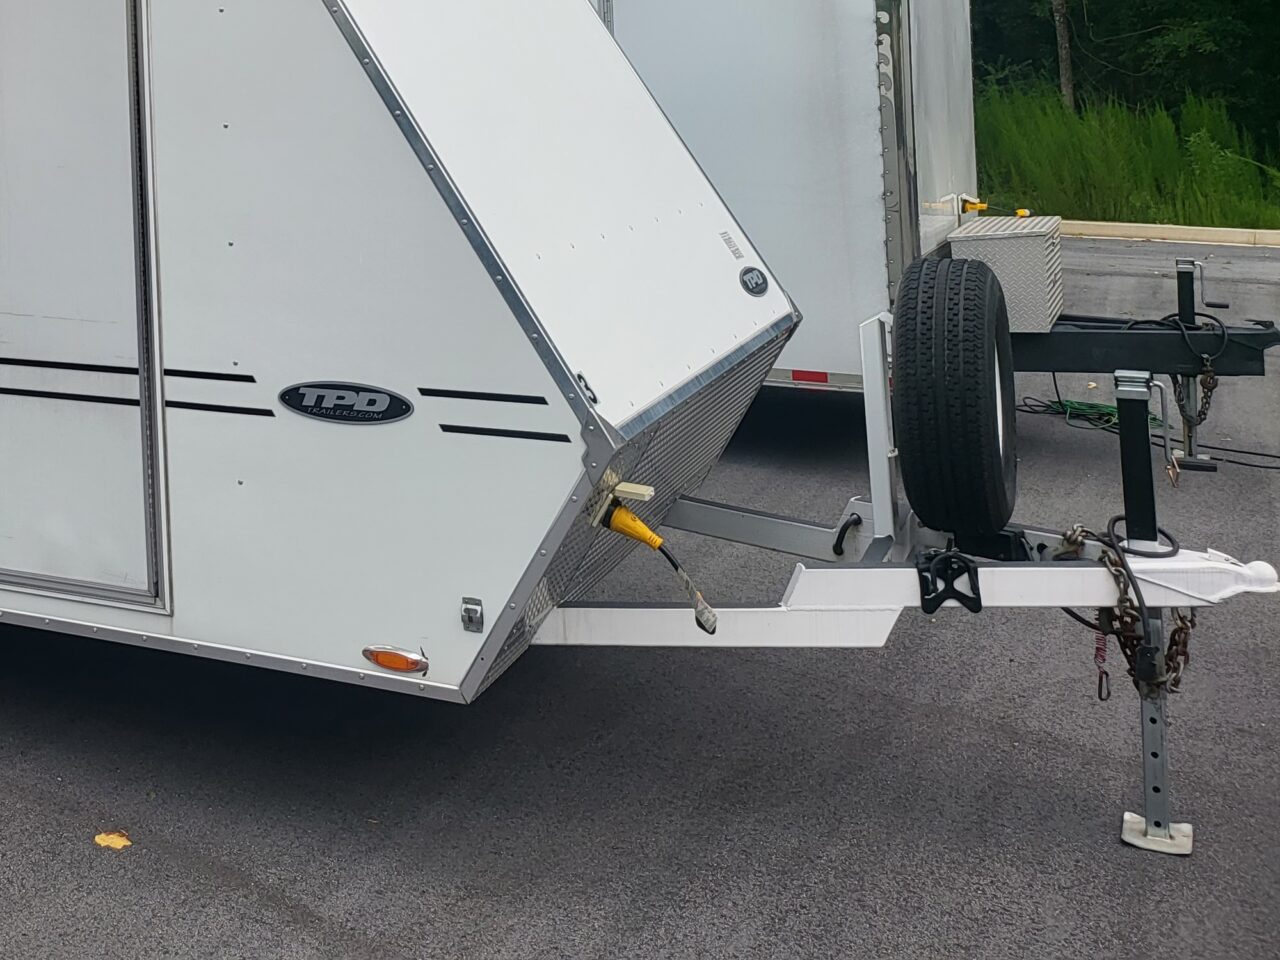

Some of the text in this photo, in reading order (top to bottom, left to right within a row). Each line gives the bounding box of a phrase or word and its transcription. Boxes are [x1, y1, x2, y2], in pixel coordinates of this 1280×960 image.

[742, 269, 764, 289] TPD
[298, 387, 390, 412] TPD
[307, 407, 384, 420] TRAILERS.COM
